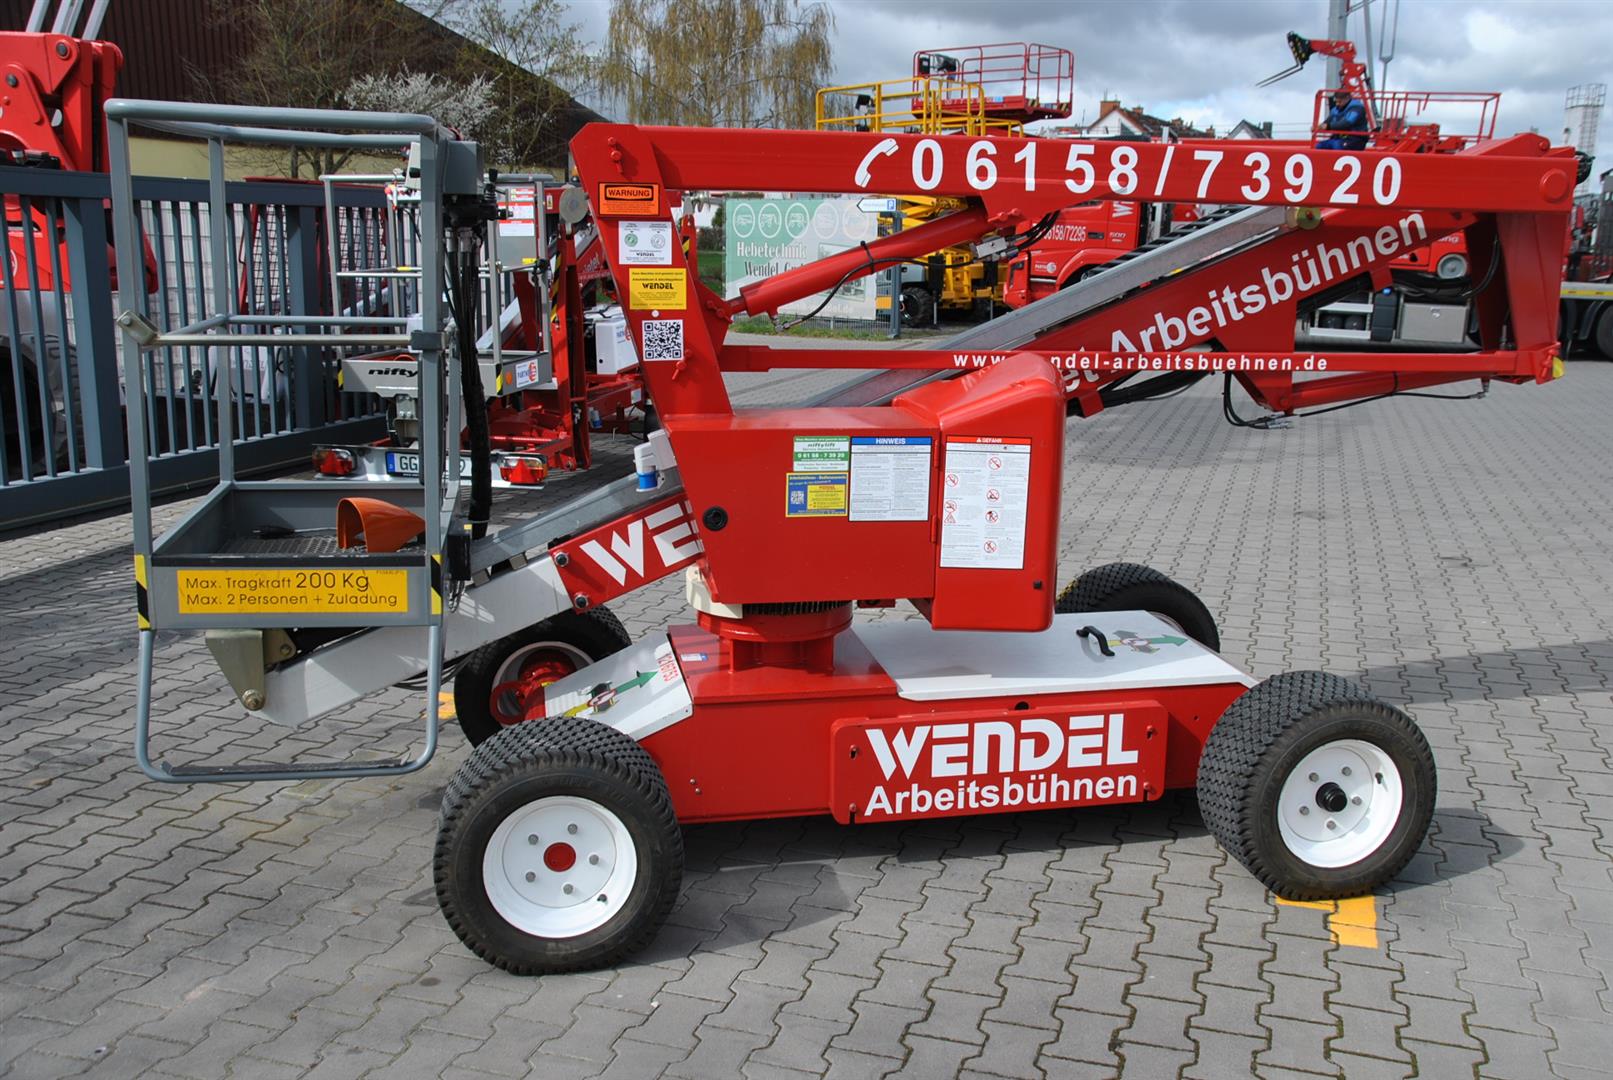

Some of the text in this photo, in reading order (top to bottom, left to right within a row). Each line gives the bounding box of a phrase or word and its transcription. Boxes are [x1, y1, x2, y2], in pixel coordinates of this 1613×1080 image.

[607, 189, 651, 198] WARNUNG
[1044, 224, 1086, 242] 6158/72295
[737, 241, 807, 259] Hebetechnik
[745, 261, 779, 277] Wendel
[641, 282, 675, 291] WENDEL
[1109, 211, 1429, 353] Arbeitsbühnen
[953, 353, 1328, 371] wwwndel-arbeitsbuehnen.de
[368, 367, 418, 378] nifty
[185, 577, 221, 589] Max.
[226, 577, 292, 591] Tragkraft
[295, 572, 336, 589] 200
[342, 572, 369, 591] Kg
[186, 593, 397, 607] Max. 2 Personen + Zuladung
[865, 713, 1139, 780] WENDEL
[864, 773, 1138, 817] Arbeitsbühnen
